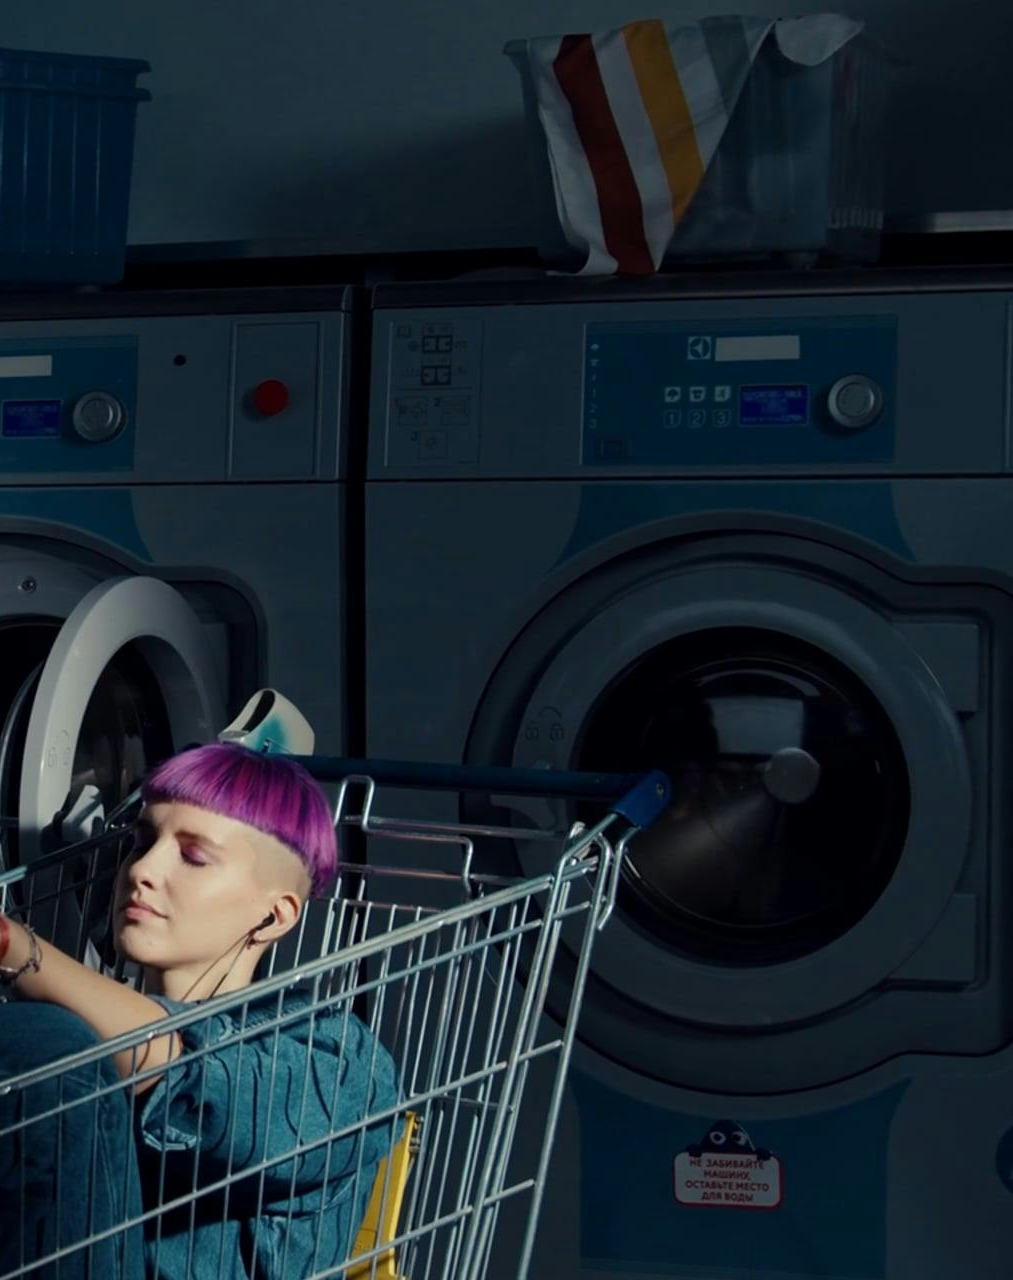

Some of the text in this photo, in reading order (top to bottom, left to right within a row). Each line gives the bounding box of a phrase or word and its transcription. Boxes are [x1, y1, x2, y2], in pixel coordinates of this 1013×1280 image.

[668, 412, 726, 424] 1 2 3
[689, 1157, 765, 1170] НЕ ЗАБИВАЙТЕ
[703, 1170, 752, 1181] МАШИНУ,
[685, 1179, 770, 1192] ОСТАВЬТЕ МЕСТО
[700, 1191, 754, 1202] ДЛЯ ВОДЫ
